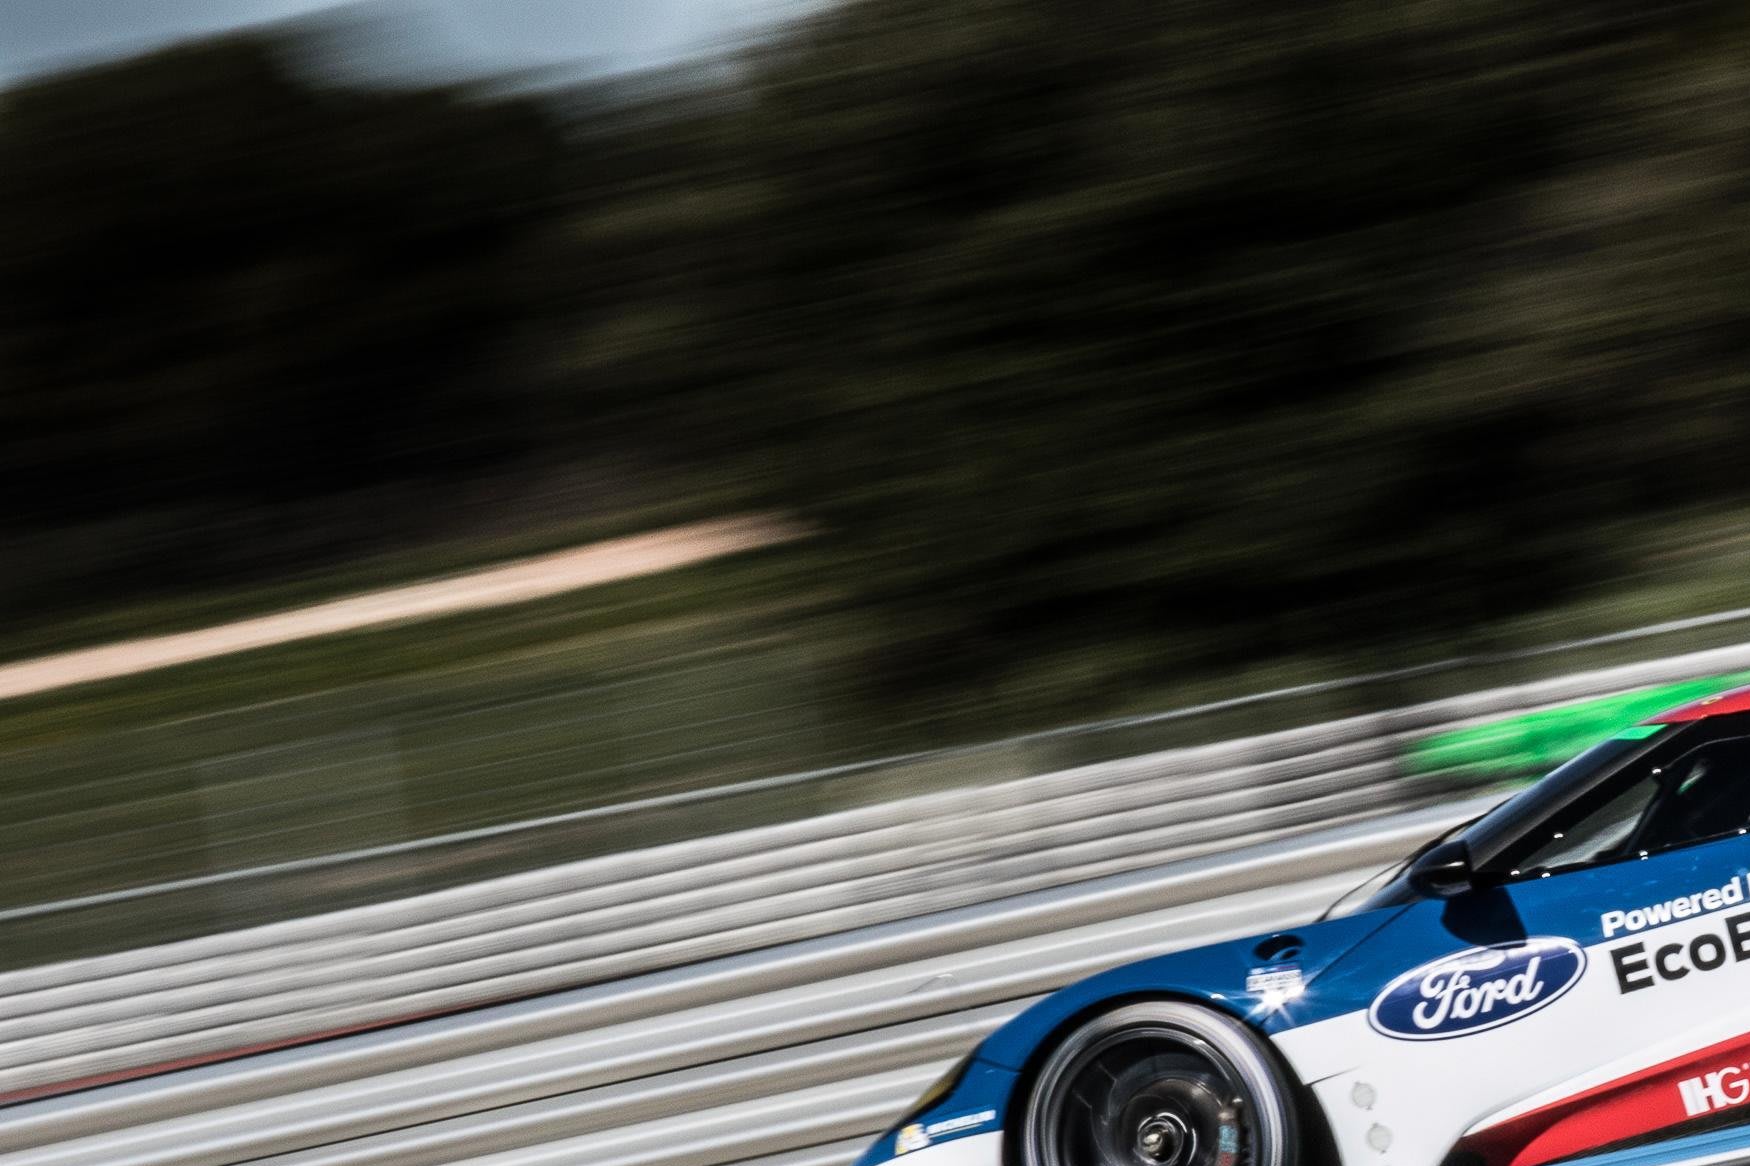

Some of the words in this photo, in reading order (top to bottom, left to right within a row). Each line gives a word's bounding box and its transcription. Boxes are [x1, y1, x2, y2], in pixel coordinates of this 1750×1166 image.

[1601, 876, 1744, 938] Powered
[1412, 949, 1545, 1030] Ford
[1677, 1066, 1750, 1117] IHG
